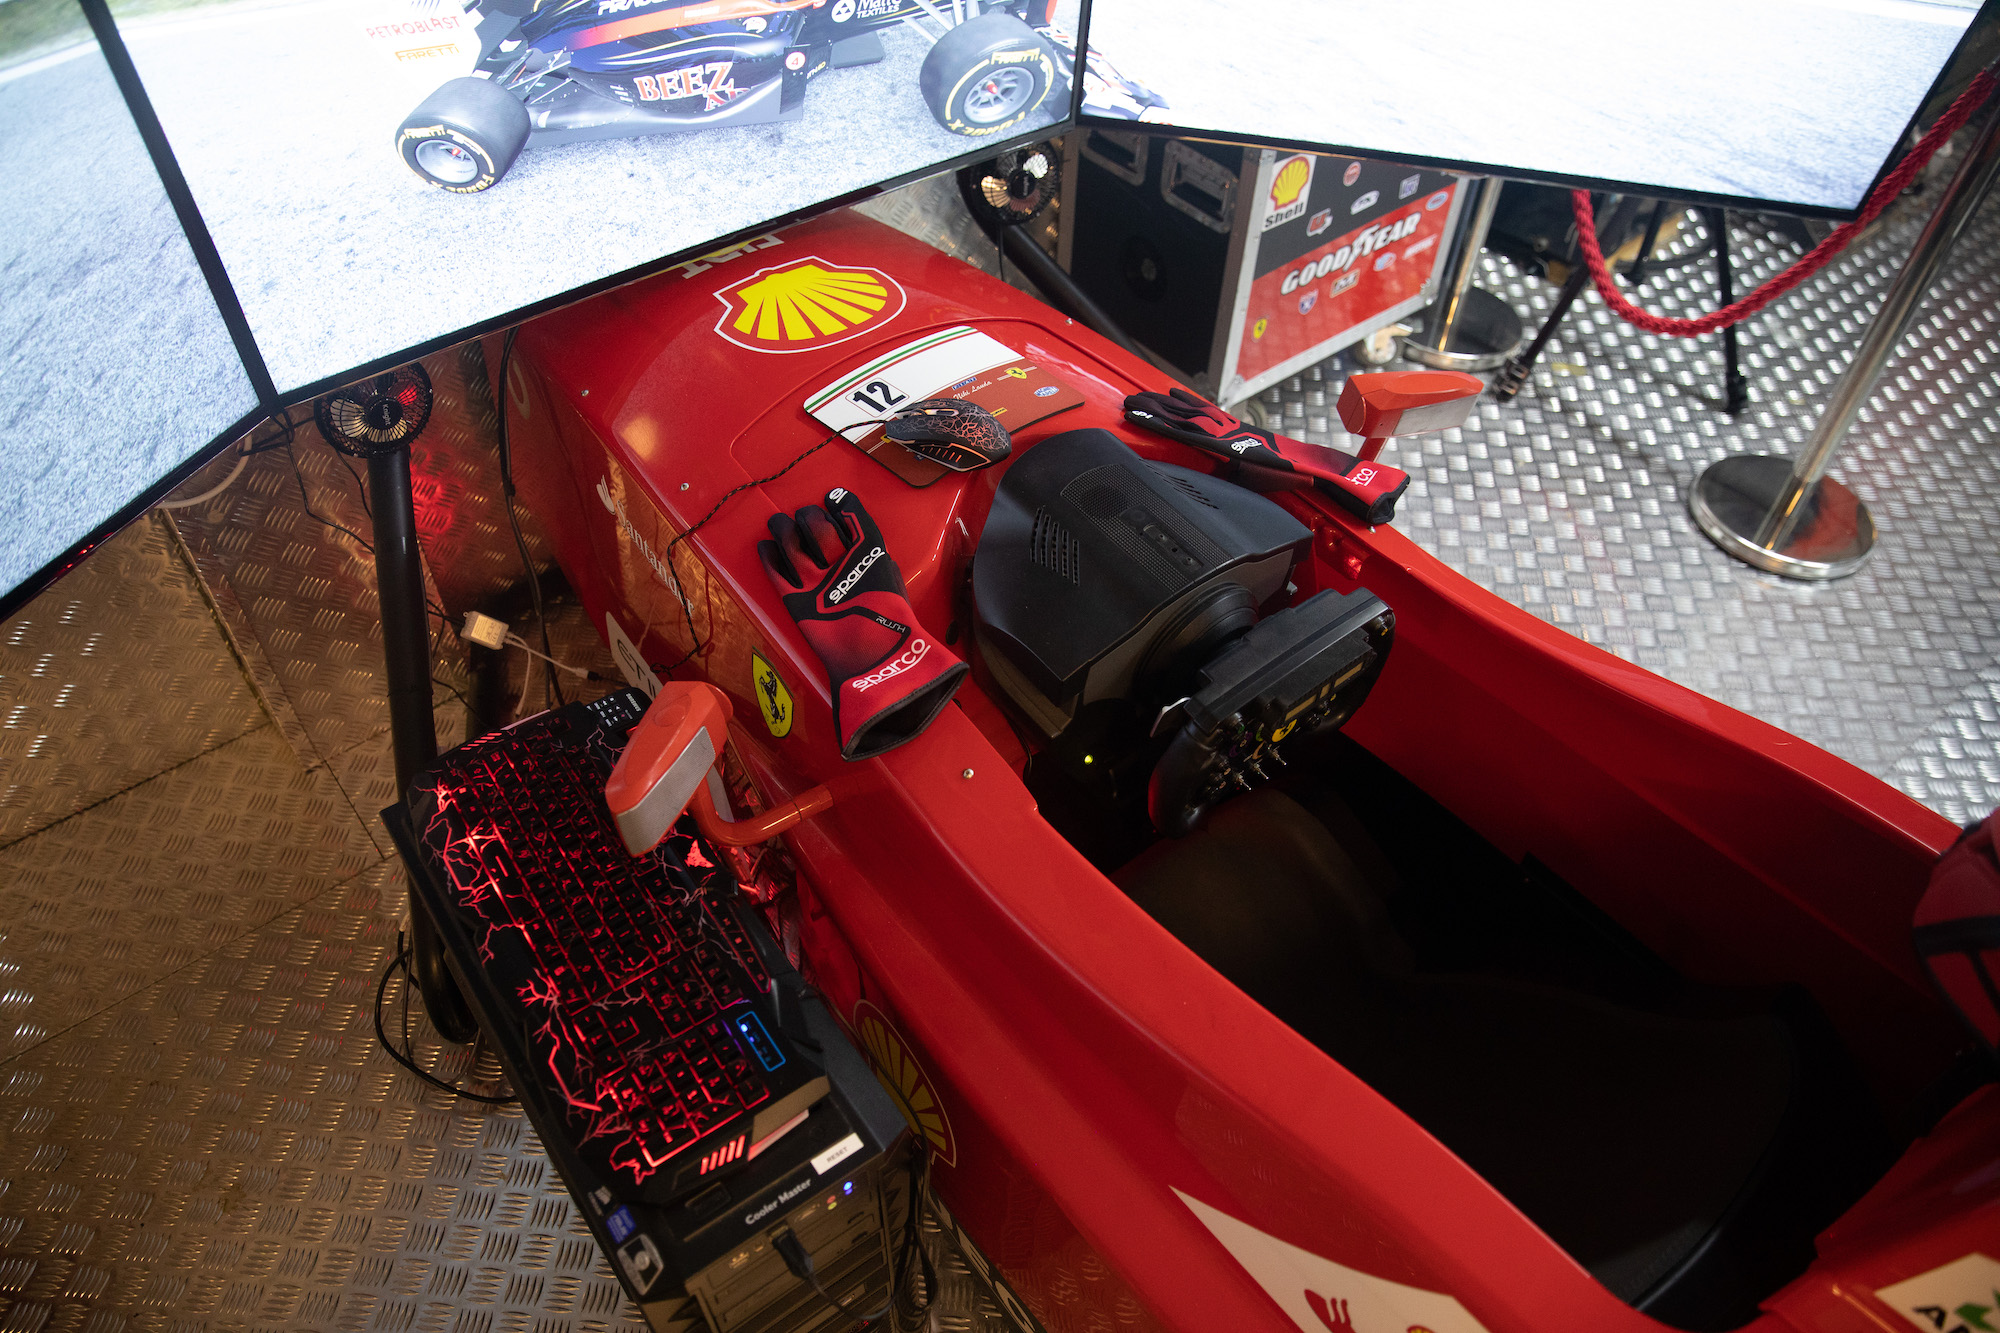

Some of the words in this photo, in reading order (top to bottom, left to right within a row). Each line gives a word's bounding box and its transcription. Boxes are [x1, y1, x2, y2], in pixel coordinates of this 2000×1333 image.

[856, 5, 900, 19] TEXTILES
[365, 16, 460, 39] PETROBLAST
[395, 43, 460, 62] FARETTI
[633, 61, 734, 101] BEEZ
[1265, 202, 1304, 228] Shell
[1281, 211, 1422, 296] GOODYEAR
[852, 381, 907, 413] 12
[828, 546, 886, 605] sparco
[875, 614, 907, 634] RUSH
[852, 638, 931, 692] sparco
[826, 1146, 849, 1165] RESET
[745, 1197, 780, 1226] Cooler
[777, 1178, 812, 1205] Master
